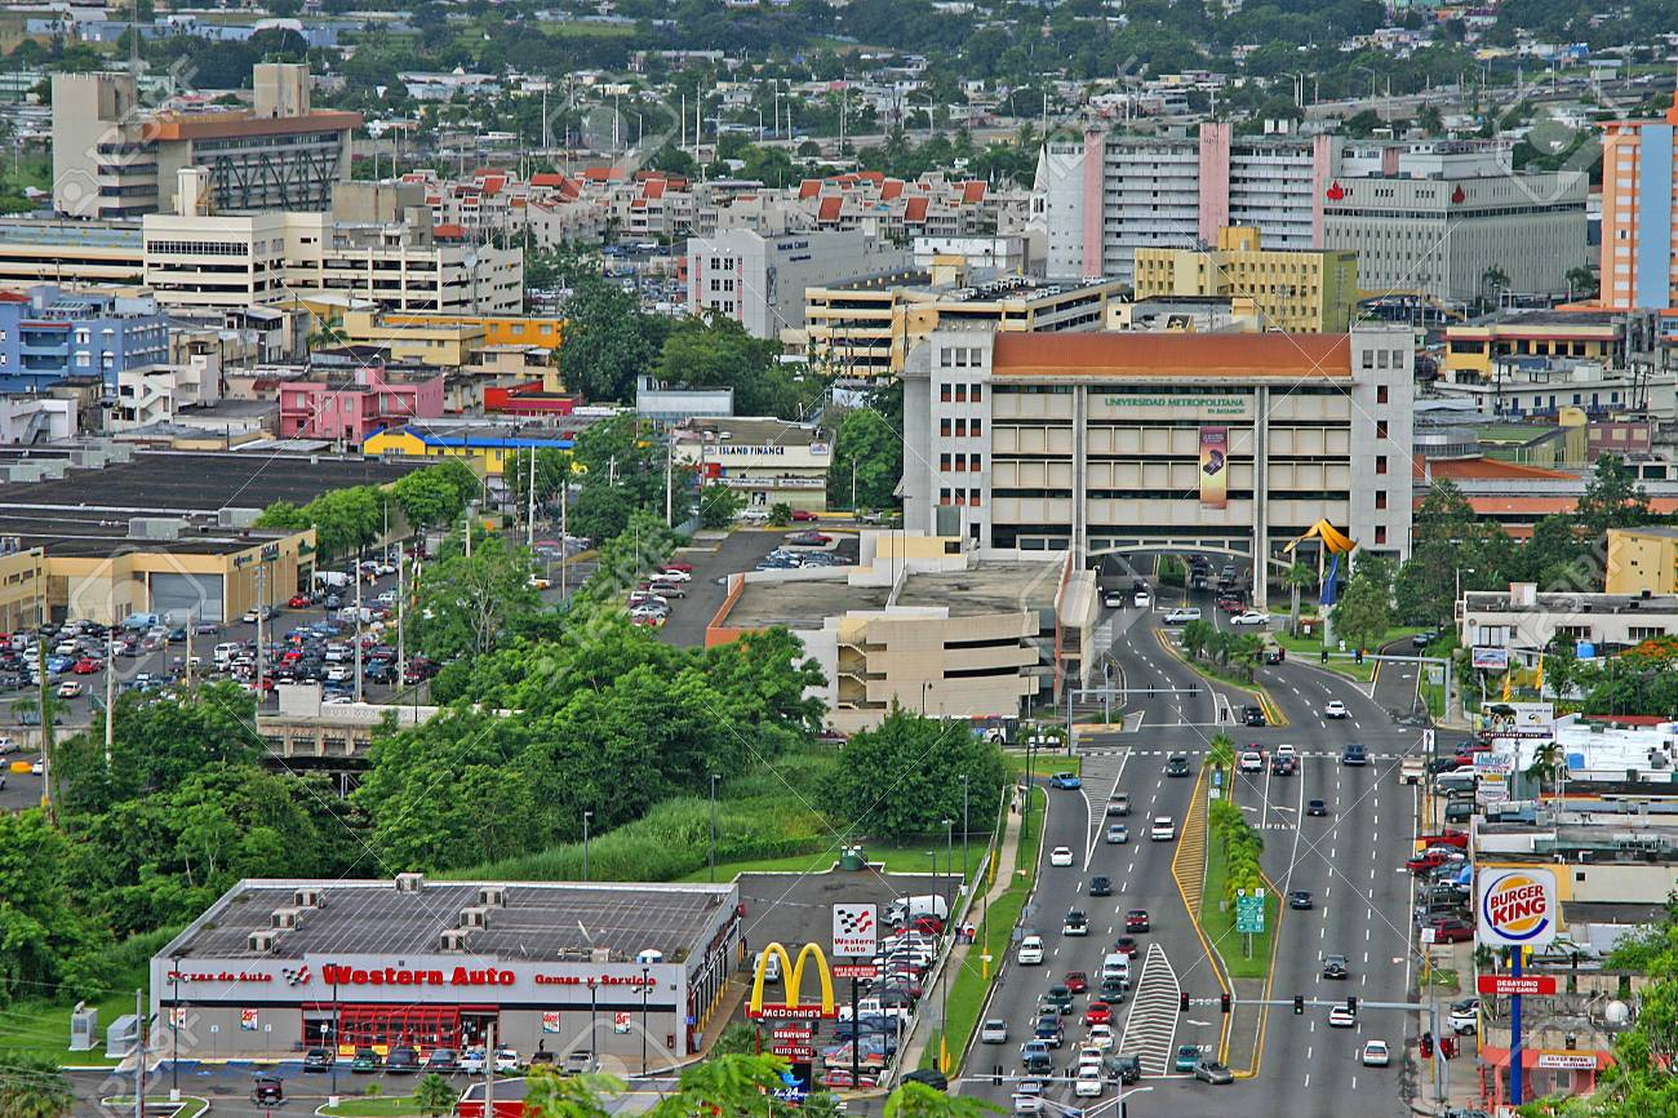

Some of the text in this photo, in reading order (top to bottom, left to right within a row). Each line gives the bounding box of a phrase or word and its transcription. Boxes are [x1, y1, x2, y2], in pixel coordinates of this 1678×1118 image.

[1105, 398, 1244, 407] UNIVERSIDAD METROPOLITANA
[719, 446, 748, 455] ISLAND
[750, 446, 785, 455] FINANCE
[1491, 885, 1544, 909] BURGER
[1493, 897, 1546, 927] KING
[167, 971, 273, 984] Pzas de Auto
[322, 965, 516, 986] Western Auto
[535, 974, 580, 985] Gomas
[601, 974, 657, 986] Servico
[762, 1009, 821, 1018] McDonald's
